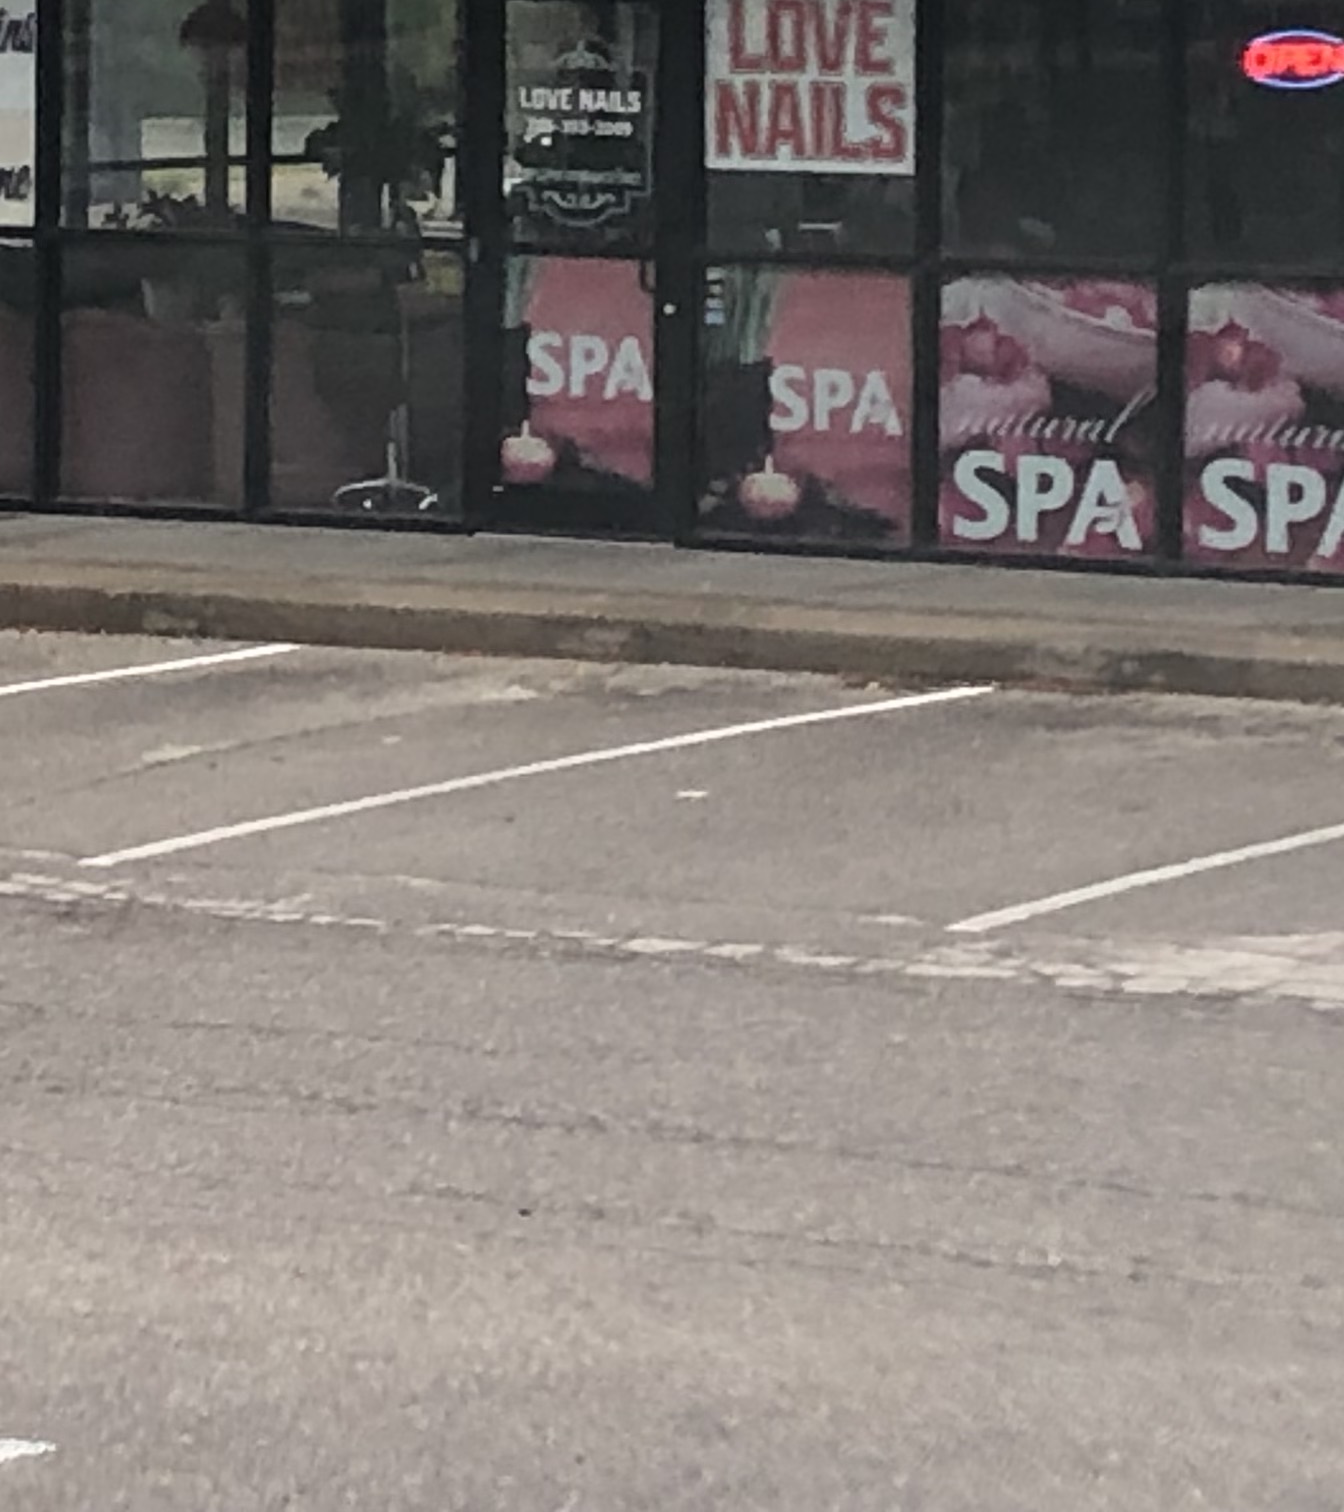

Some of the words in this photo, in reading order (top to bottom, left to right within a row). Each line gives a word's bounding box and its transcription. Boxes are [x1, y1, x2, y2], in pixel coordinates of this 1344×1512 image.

[519, 87, 573, 110] LOVE
[578, 89, 642, 113] NAILS
[714, 79, 908, 162] NAILS
[526, 331, 654, 401] SPA
[768, 364, 904, 436] SPA
[953, 450, 1143, 551] SPA
